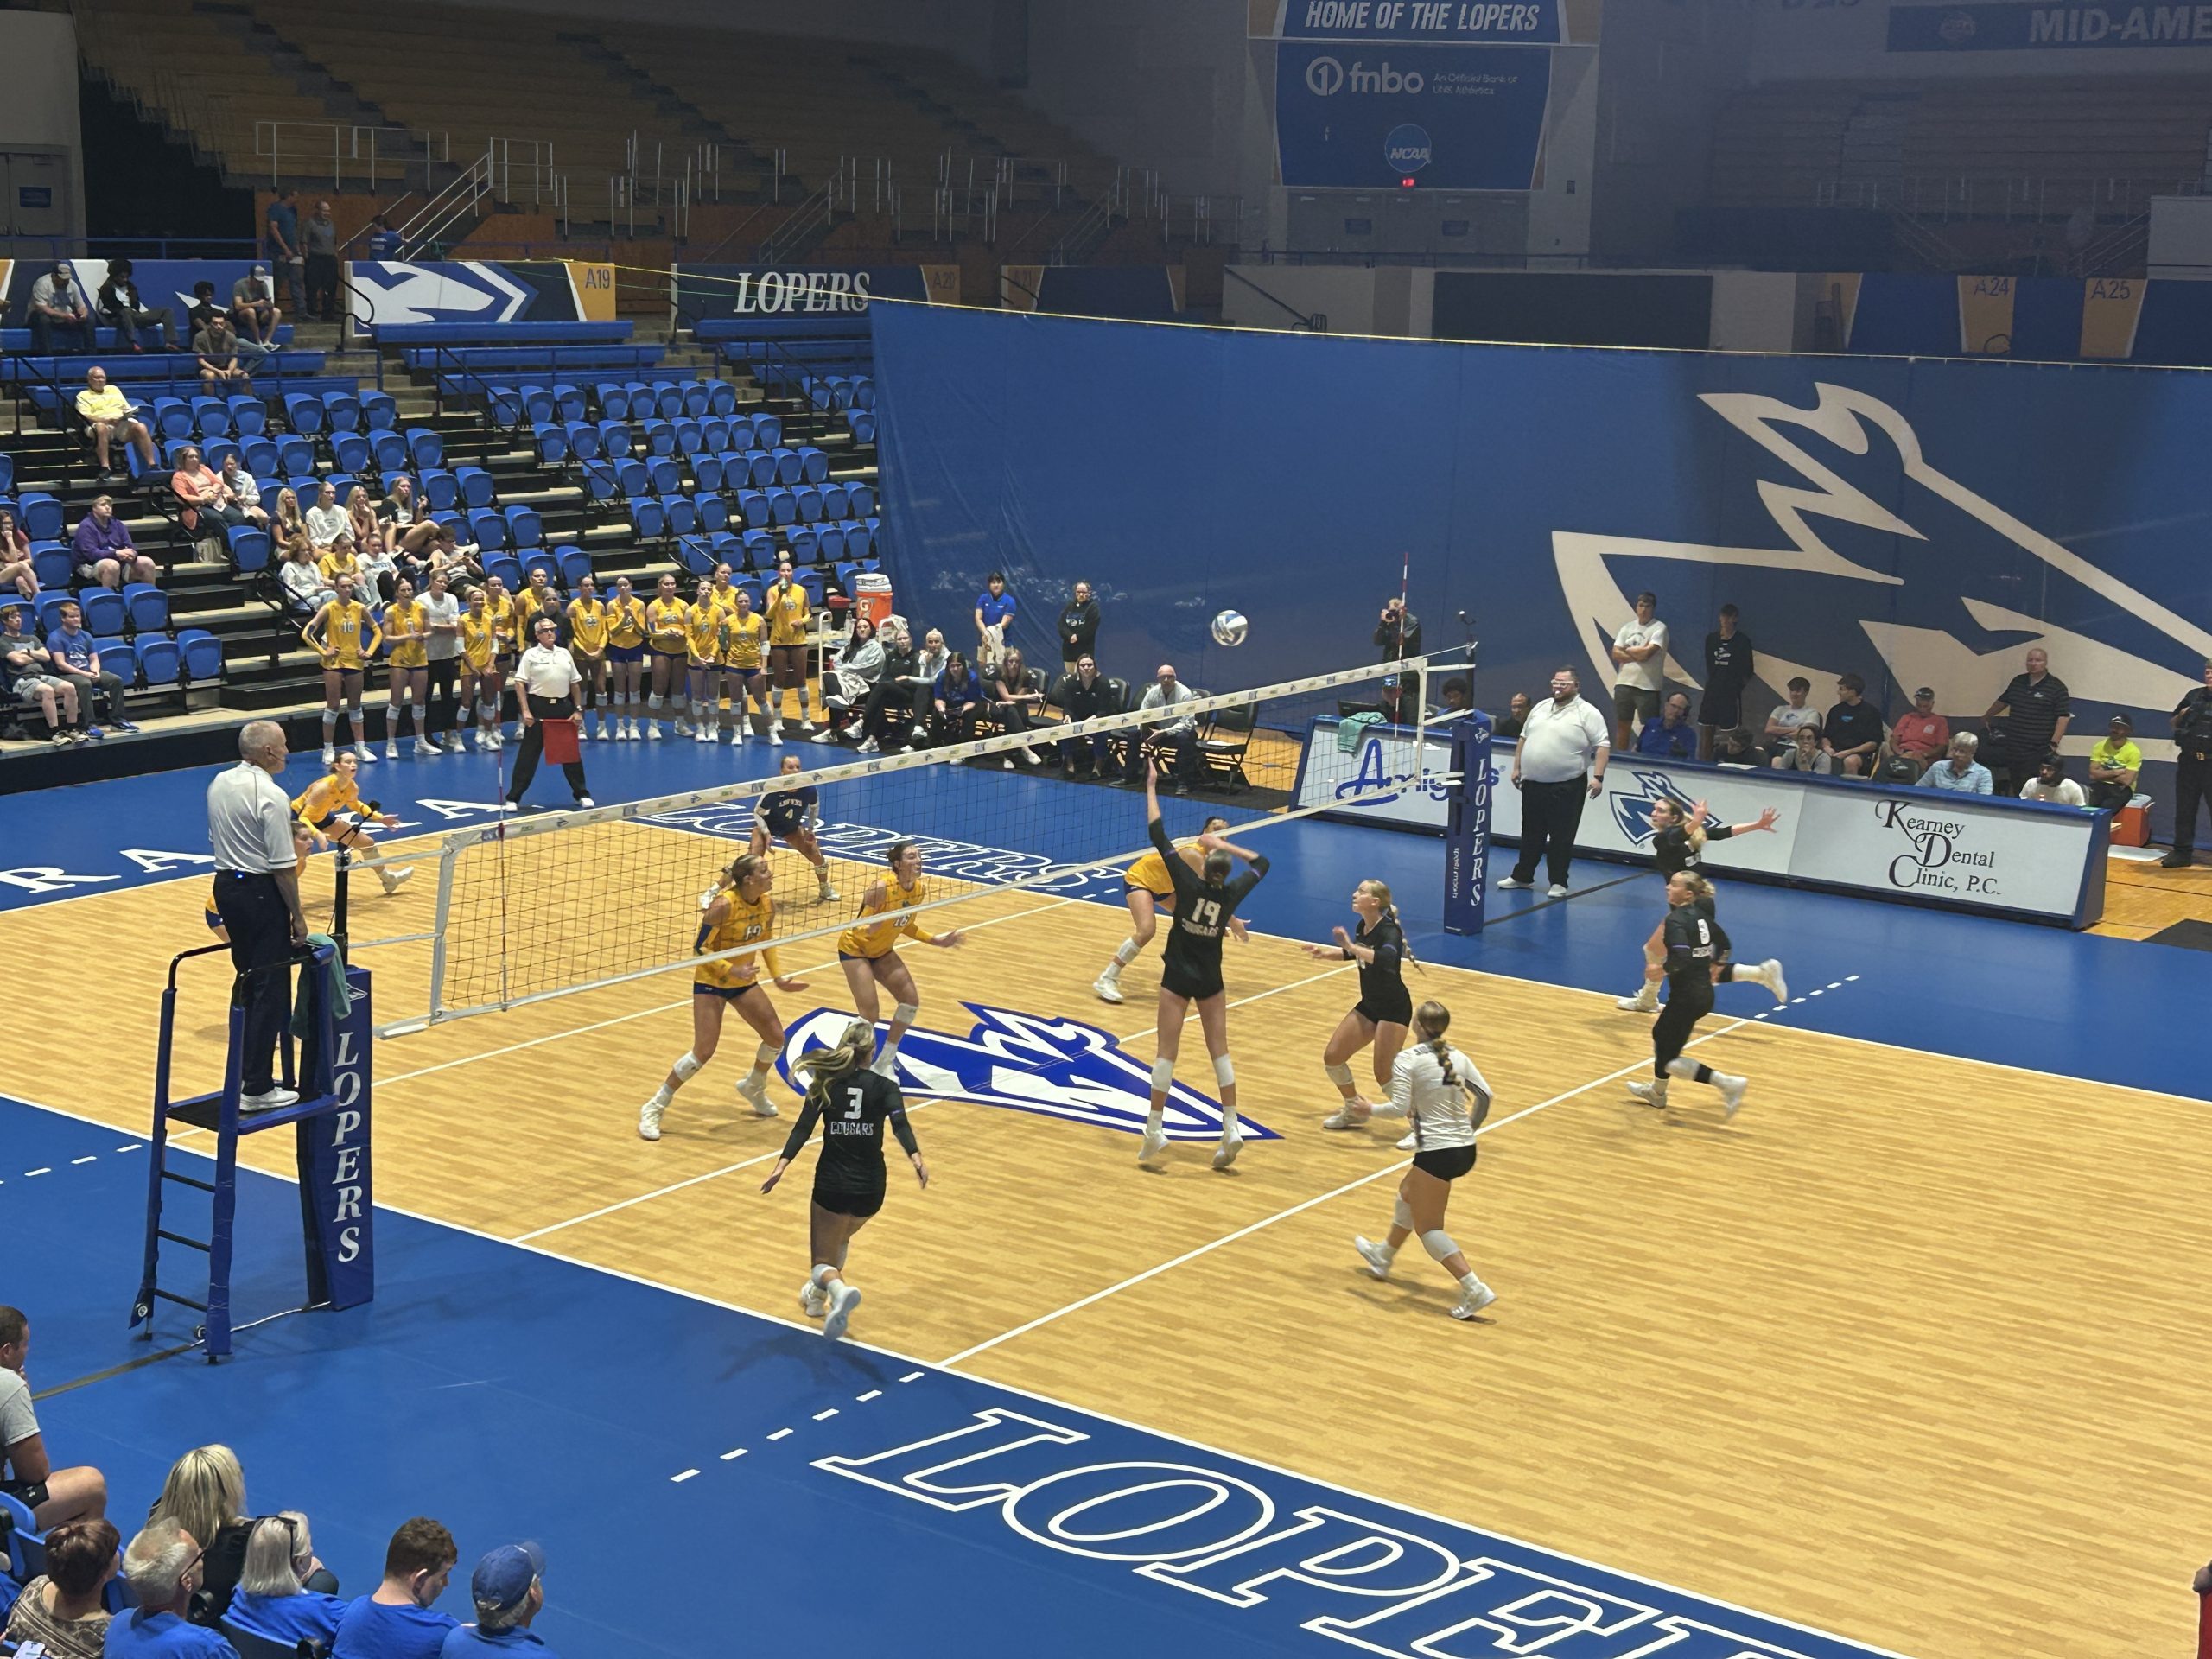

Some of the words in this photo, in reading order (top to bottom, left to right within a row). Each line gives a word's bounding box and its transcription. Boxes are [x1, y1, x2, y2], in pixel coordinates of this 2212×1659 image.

[1305, 1, 1370, 28] HOME
[1375, 2, 1404, 29] OF
[1410, 3, 1452, 29] THE
[1456, 3, 1540, 31] LOPERS
[1349, 61, 1424, 94] fnbo
[1390, 147, 1428, 162] NCAA
[584, 269, 610, 289] A19
[734, 272, 870, 313] LOPERS
[1974, 276, 2010, 296] A24
[2091, 279, 2131, 300] A25
[1471, 758, 1487, 907] LOPERS
[1874, 799, 1966, 842] Kearney
[1914, 832, 1995, 868] Dental
[1888, 855, 1959, 893] Clinic,
[1966, 874, 2002, 895] P.C.
[1192, 898, 1221, 926] 19
[844, 1087, 863, 1119] 3
[830, 1122, 874, 1136] COUGARS
[331, 1032, 363, 1263] LOPERS
